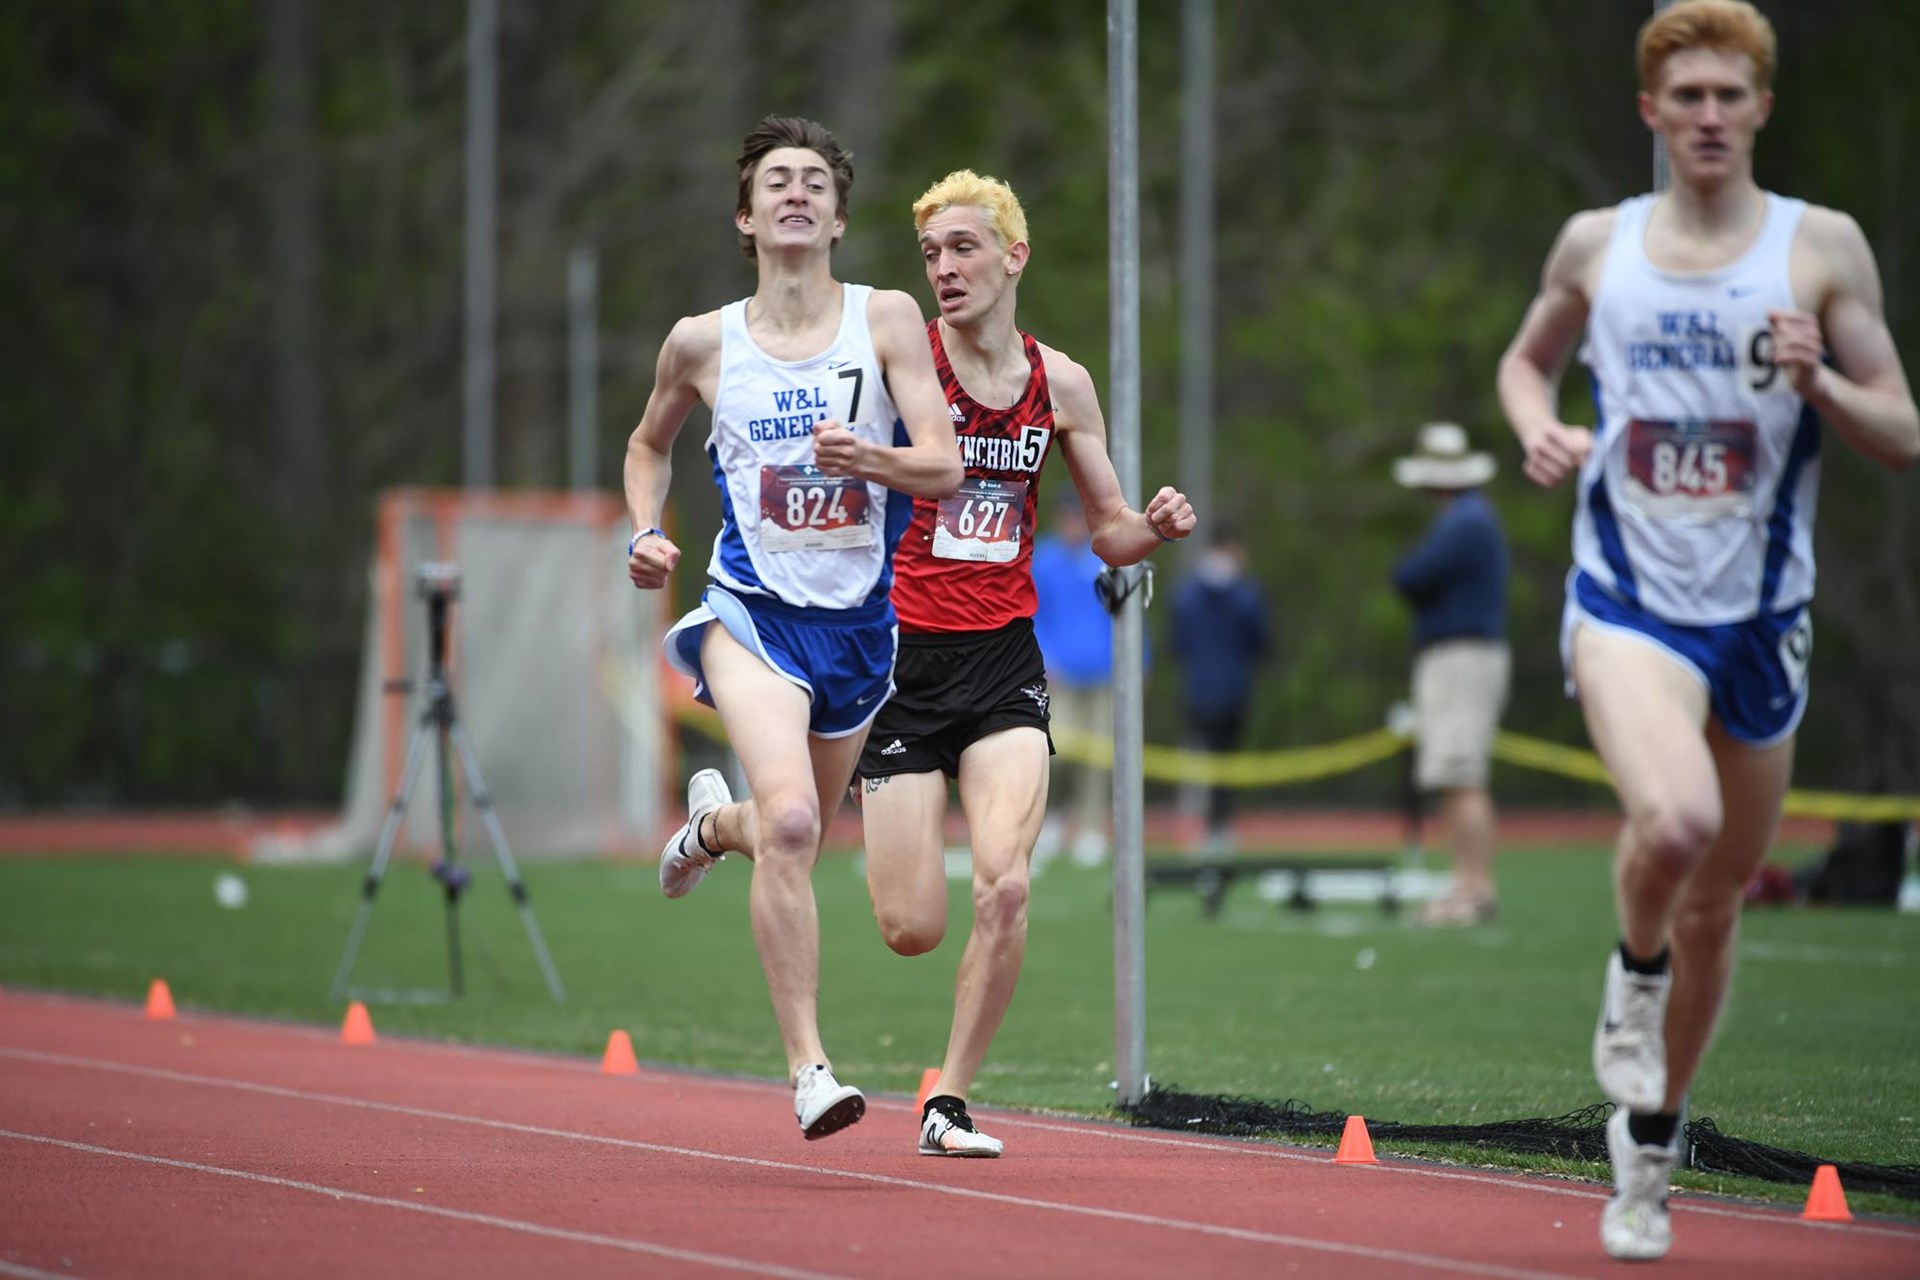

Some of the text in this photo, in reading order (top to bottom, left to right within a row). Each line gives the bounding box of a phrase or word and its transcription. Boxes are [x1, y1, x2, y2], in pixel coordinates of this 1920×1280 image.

[1751, 330, 1778, 390] 9
[773, 387, 828, 413] W&L
[838, 367, 863, 423] 7
[1022, 428, 1043, 468] 5
[1652, 441, 1728, 494] 845
[786, 486, 848, 527] 824
[958, 499, 1009, 538] 627
